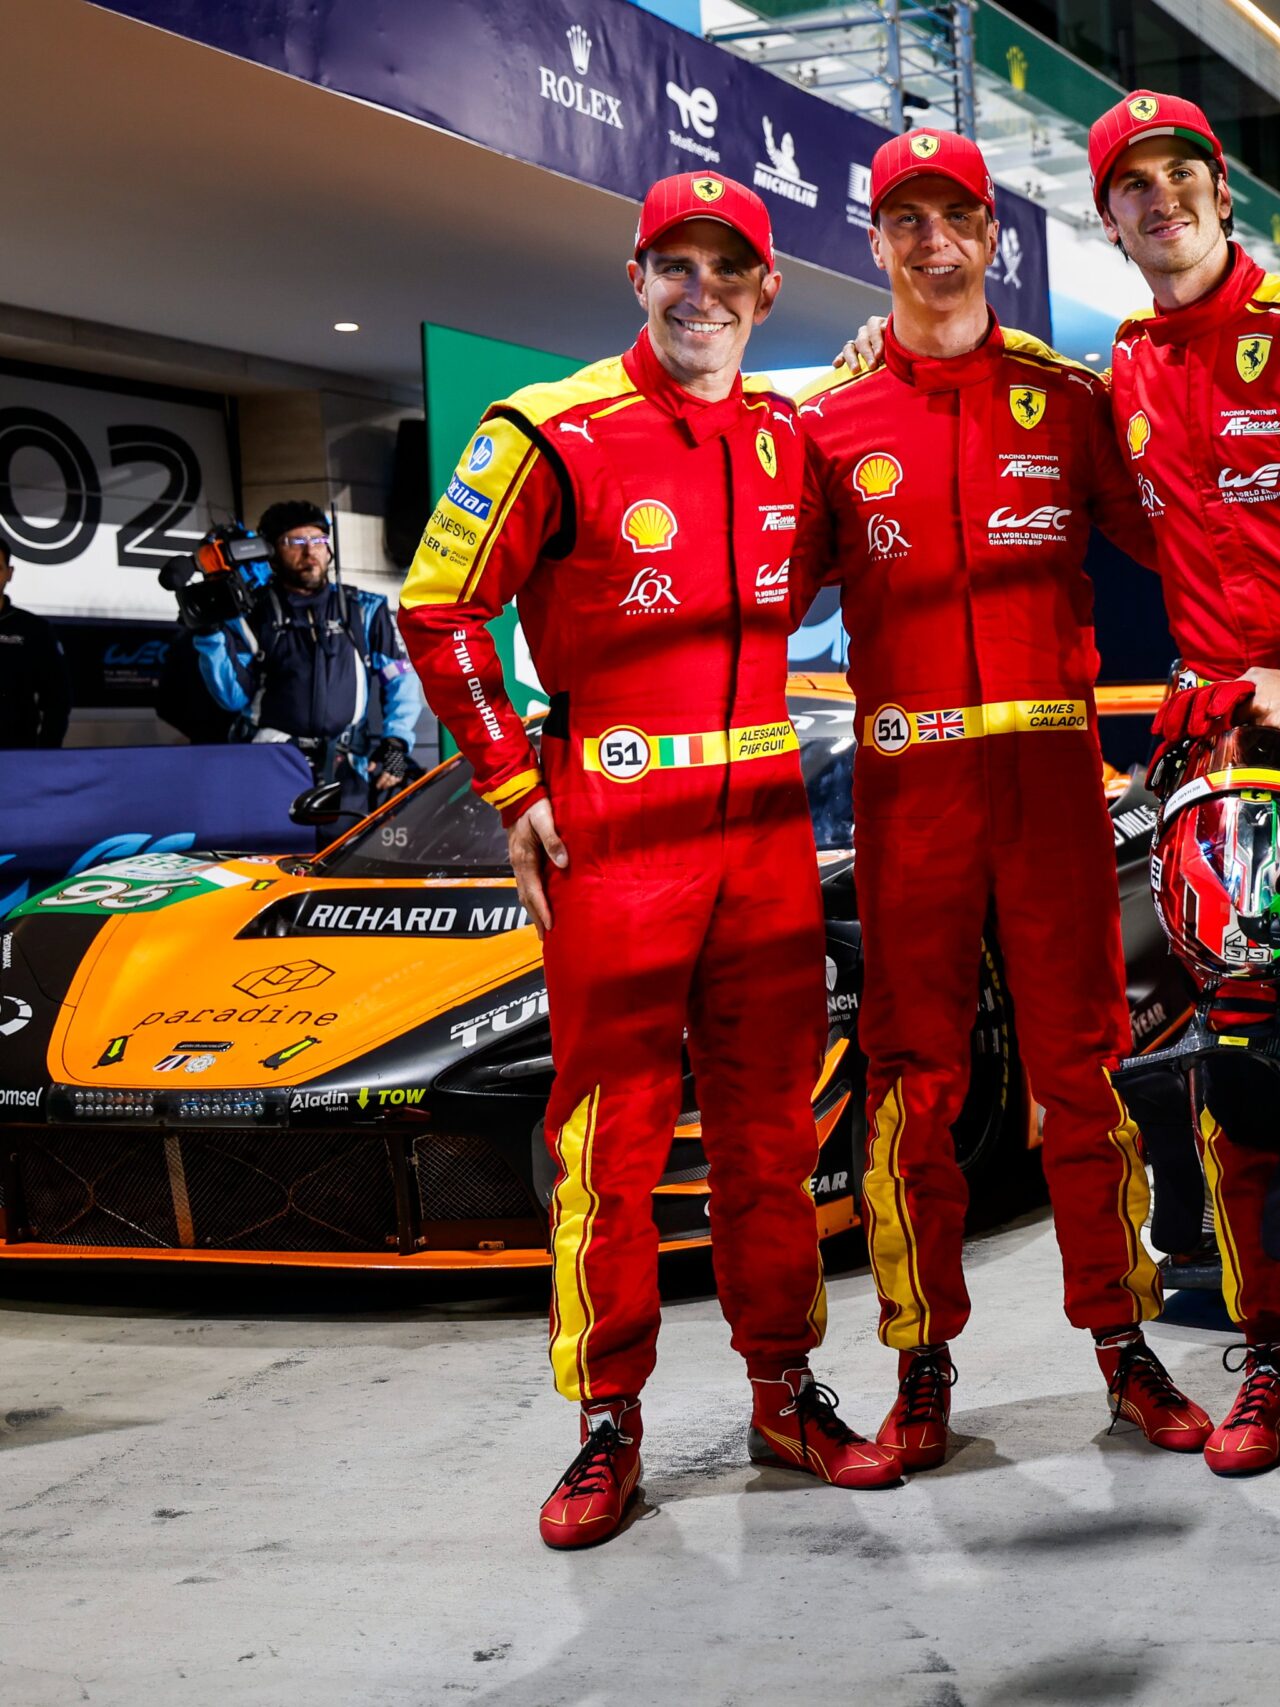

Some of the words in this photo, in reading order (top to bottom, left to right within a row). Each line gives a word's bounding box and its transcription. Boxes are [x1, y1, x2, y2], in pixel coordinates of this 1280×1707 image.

[538, 65, 624, 130] ROLEX
[753, 169, 818, 208] MICHELIN
[470, 437, 492, 470] hp
[447, 477, 490, 513] etilar
[432, 510, 477, 545] ENESYS
[987, 505, 1072, 531] WEC
[756, 558, 790, 587] WE
[453, 629, 475, 675] MILE
[467, 677, 504, 742] RICHARD
[1028, 703, 1075, 715] JAMES
[1030, 715, 1085, 727] CALADO
[878, 719, 905, 741] 51
[606, 742, 643, 766] 51
[381, 827, 408, 848] 95
[38, 879, 200, 909] 95
[307, 904, 457, 932] RICHARD
[468, 906, 527, 931] MIL
[133, 1004, 339, 1030] paradine
[290, 1090, 349, 1109] Aladin
[378, 1088, 426, 1105] TOW
